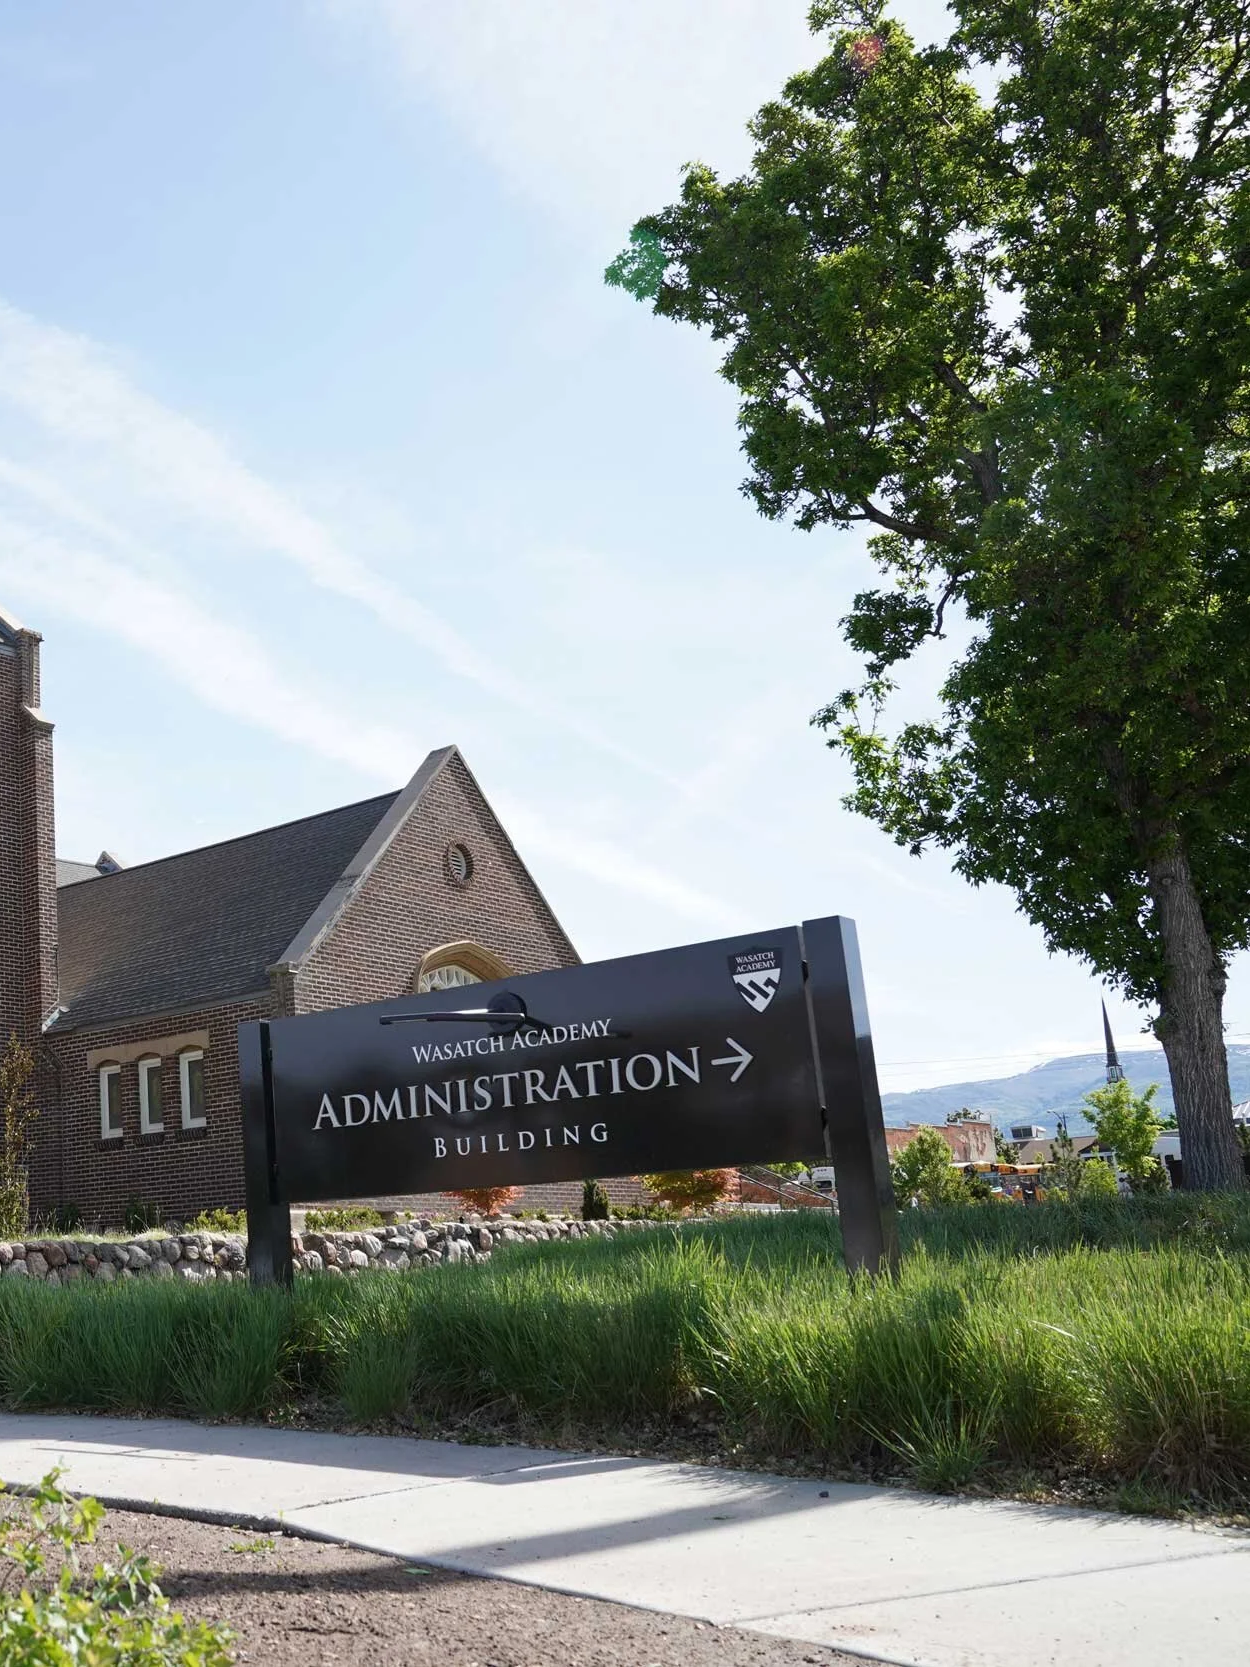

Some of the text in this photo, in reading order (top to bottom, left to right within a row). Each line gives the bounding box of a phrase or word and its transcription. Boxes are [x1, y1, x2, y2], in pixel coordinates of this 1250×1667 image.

[735, 951, 775, 964] WASATCH
[736, 959, 776, 973] ACADEMY
[411, 1018, 612, 1064] WASATCH ACADEMY
[312, 1046, 702, 1131] ADMINISTRATION
[434, 1122, 609, 1159] BUILDING
